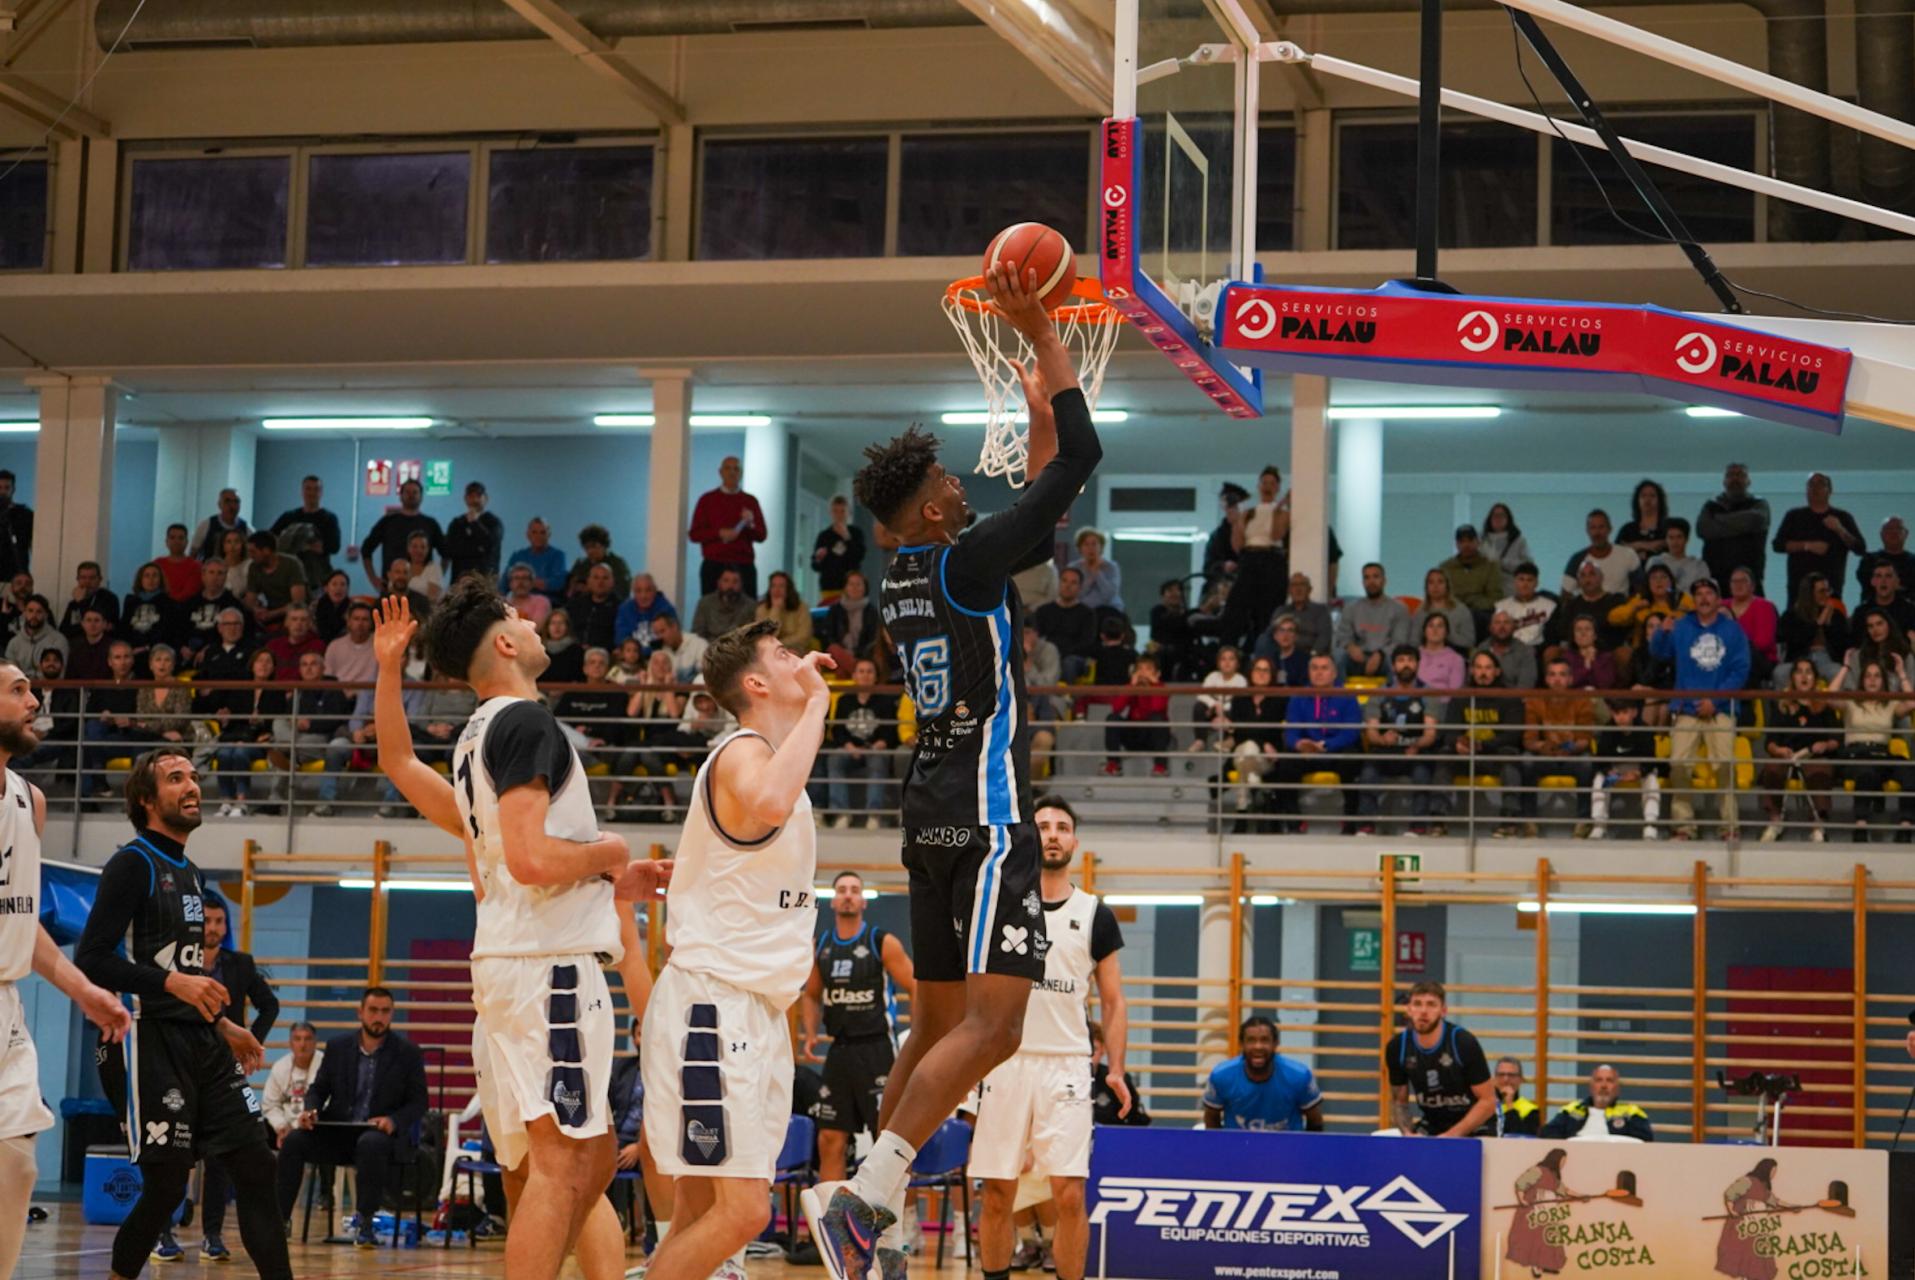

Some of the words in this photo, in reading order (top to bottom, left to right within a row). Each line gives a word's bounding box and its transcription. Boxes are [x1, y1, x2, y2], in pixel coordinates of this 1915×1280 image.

[1106, 209, 1118, 260] PALAU
[1281, 302, 1377, 318] SERVICIOS
[1504, 313, 1602, 330] SERVICIOS
[1281, 316, 1376, 343] PALAU
[1504, 328, 1601, 356] PALAU
[1723, 340, 1823, 368] SERVICIOS
[1720, 354, 1820, 394] PALAU
[882, 603, 897, 625] DA
[898, 598, 936, 618] SILVA
[182, 894, 204, 922] 22
[831, 960, 853, 977] 12
[1426, 1069, 1440, 1087] 2
[1528, 1204, 1571, 1227] FORN
[1737, 1215, 1783, 1238] FORN
[1161, 1227, 1271, 1244] EQUIPACIONES
[1273, 1231, 1371, 1248] DEPORTIVAS
[1544, 1221, 1634, 1246] GRANJA
[1755, 1231, 1847, 1257] GRANJA
[1577, 1245, 1655, 1270] COSTA
[1788, 1258, 1869, 1280] COSTA
[1214, 1264, 1339, 1280] www.pentexsport.com
